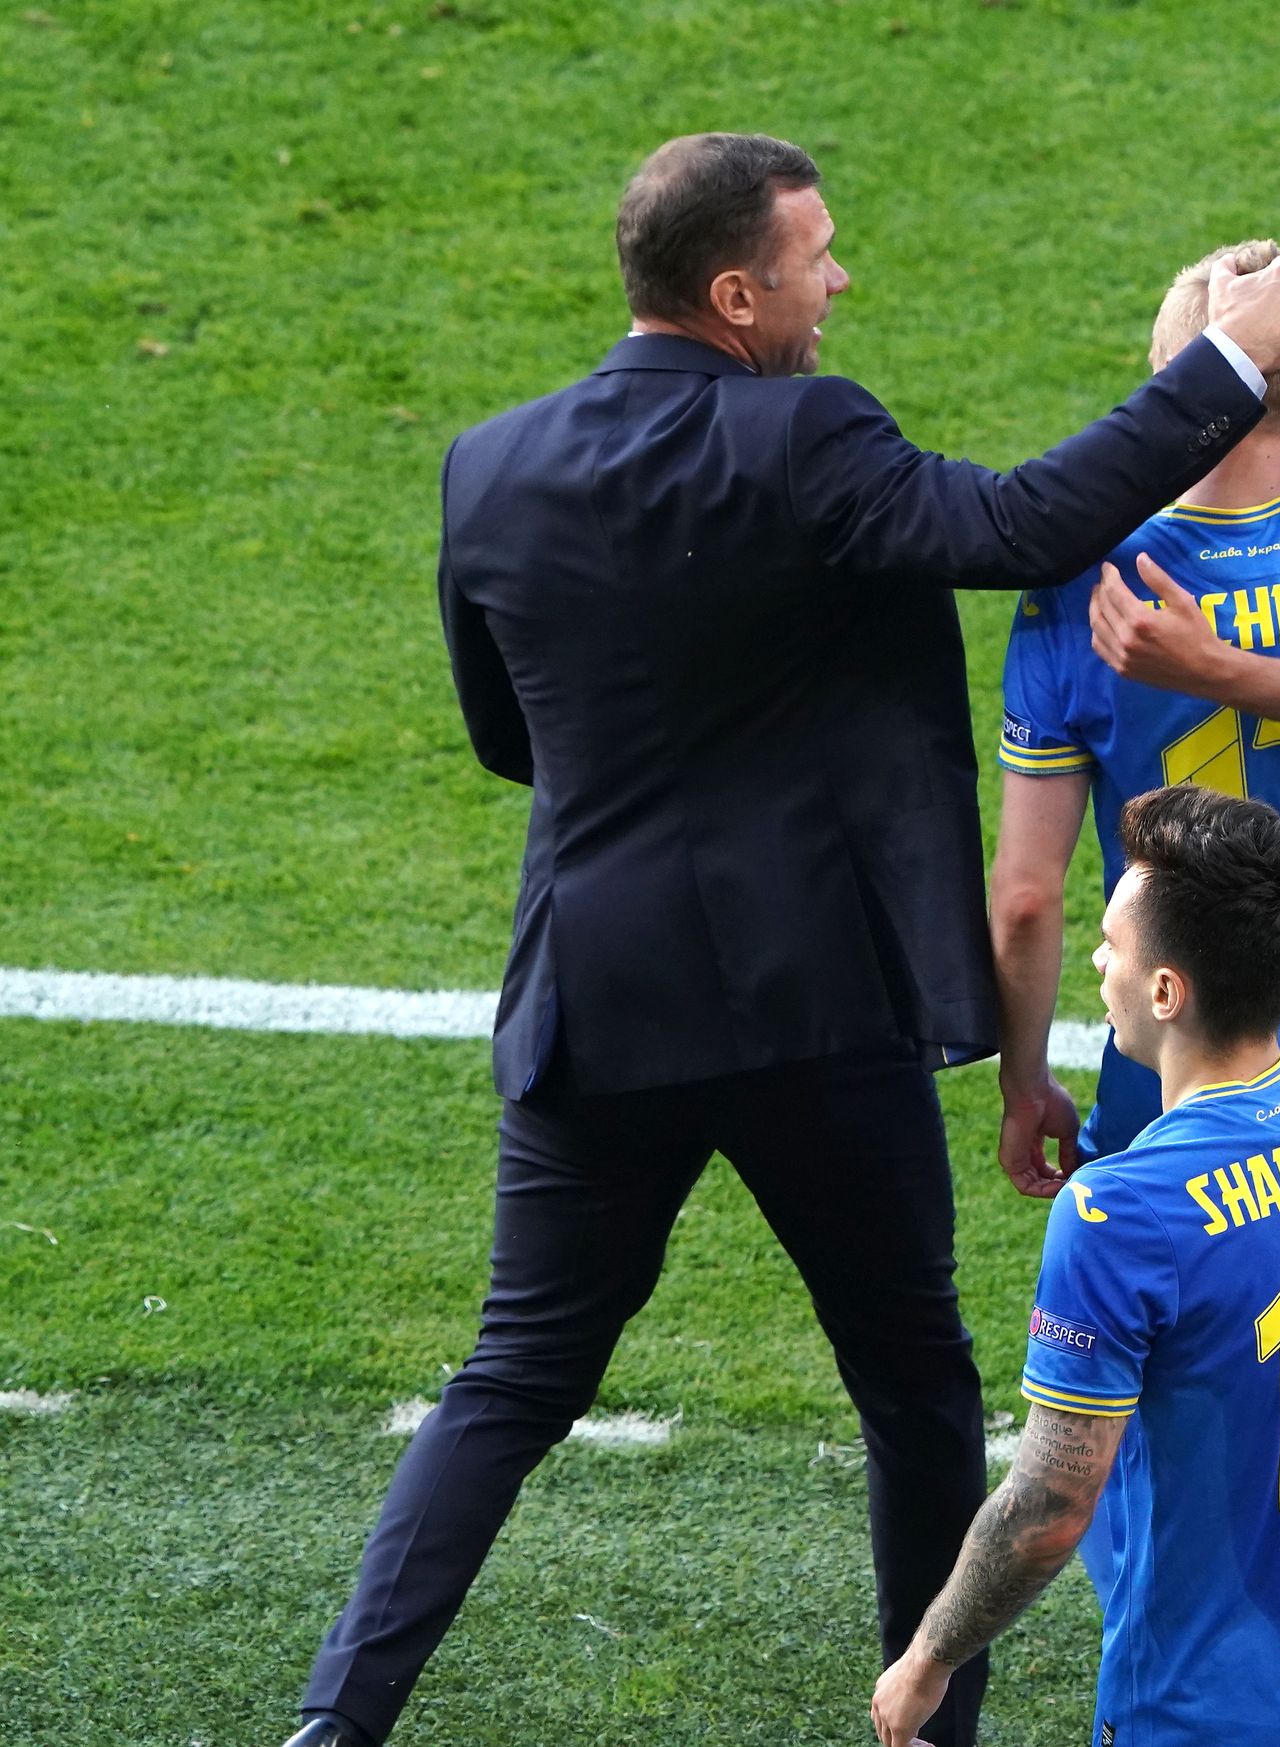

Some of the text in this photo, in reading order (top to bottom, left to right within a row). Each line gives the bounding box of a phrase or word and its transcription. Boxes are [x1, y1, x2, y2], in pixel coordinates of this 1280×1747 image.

[1199, 546, 1243, 560] Слава
[1039, 1318, 1096, 1350] RESPECT
[1051, 1422, 1073, 1436] que
